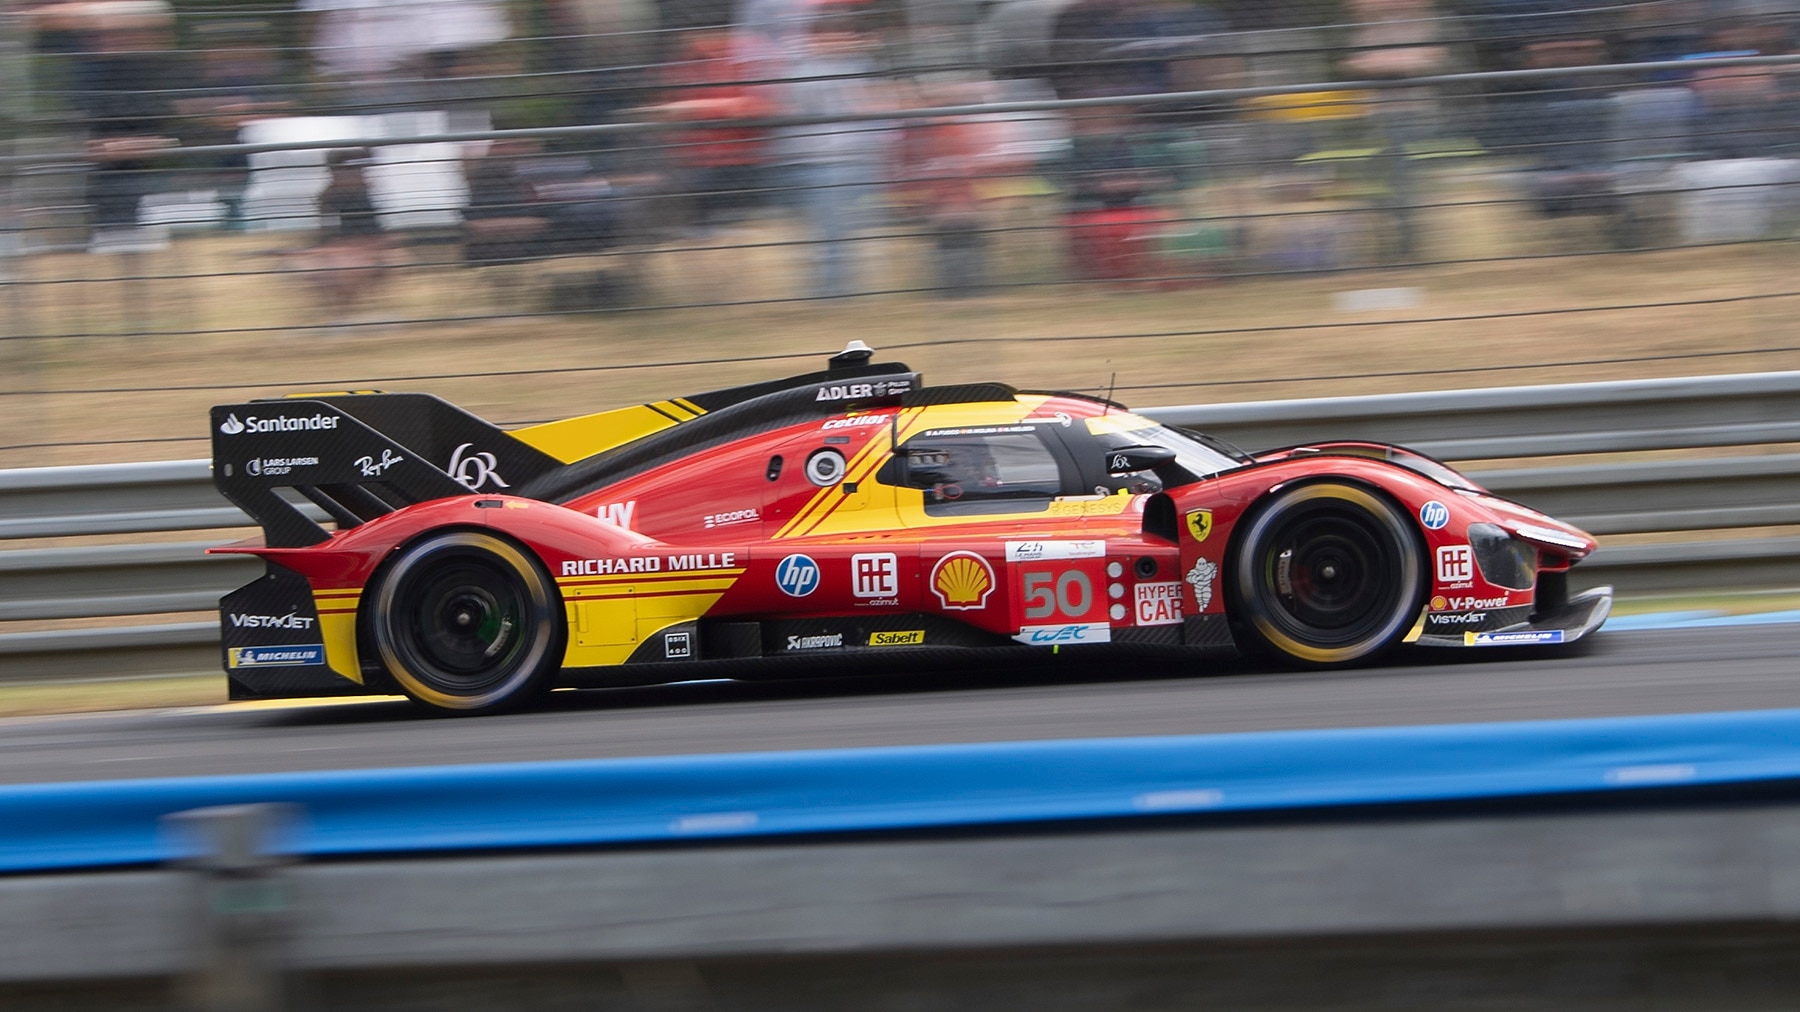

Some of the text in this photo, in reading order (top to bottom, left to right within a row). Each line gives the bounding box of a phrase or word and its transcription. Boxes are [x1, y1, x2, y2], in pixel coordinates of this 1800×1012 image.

[815, 384, 873, 401] ADLER
[246, 413, 340, 433] Santander
[263, 457, 319, 467] LARS LARSEN
[263, 467, 291, 475] GROUP
[715, 508, 759, 523] ECOPOL
[1062, 502, 1120, 515] GENESYS
[1425, 503, 1445, 528] hp
[562, 553, 735, 576] RICHARD MILLE
[782, 555, 815, 595] hp
[1023, 570, 1093, 619] 50
[1138, 584, 1183, 600] HYPER
[1139, 599, 1184, 622] CAR
[1449, 596, 1508, 610] V-Power
[875, 632, 918, 644] Sabelt
[1031, 626, 1089, 641] WEC
[1492, 633, 1553, 641] MICHELIN
[256, 650, 317, 661] MICHELIN
